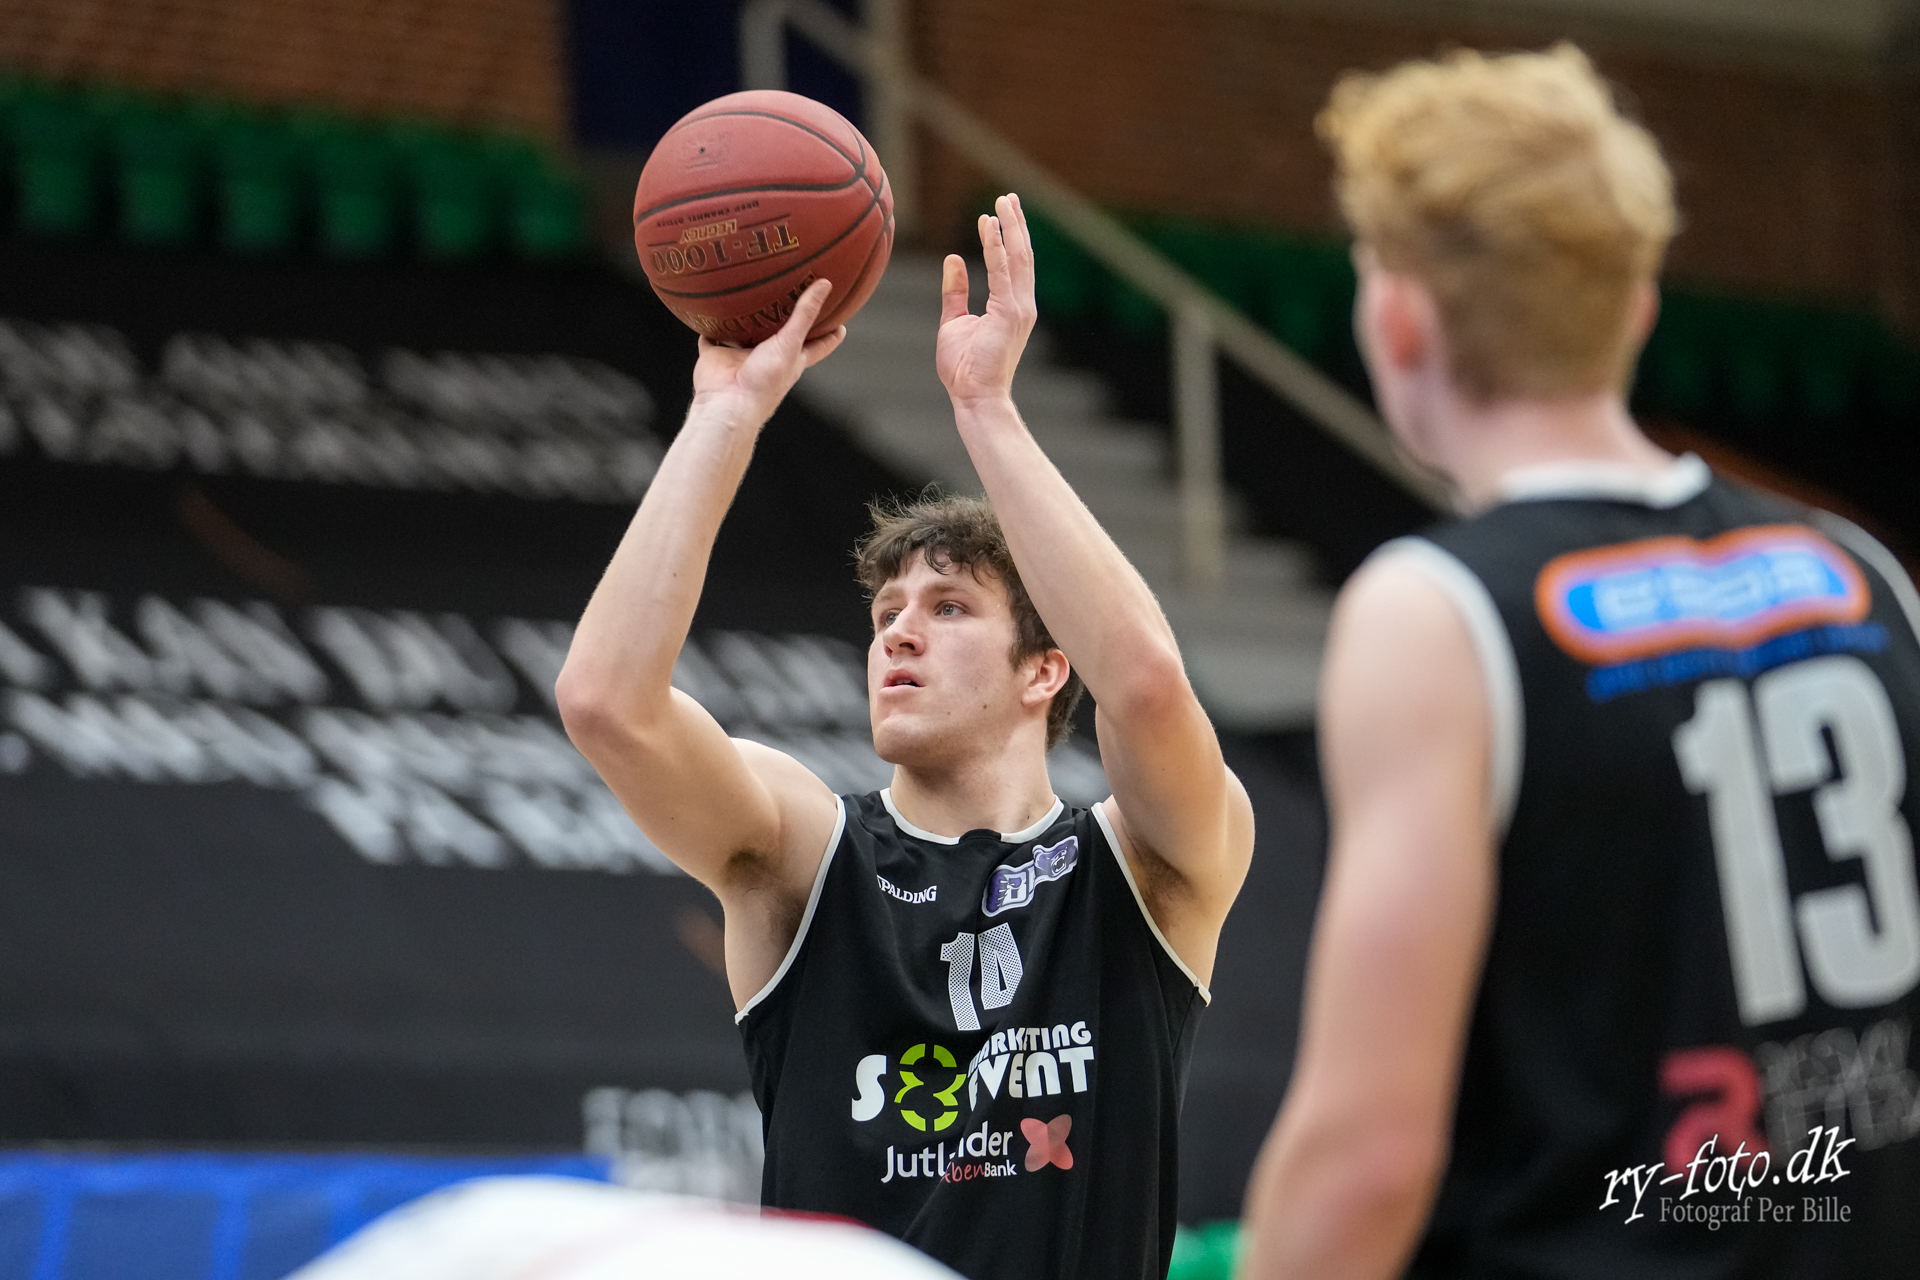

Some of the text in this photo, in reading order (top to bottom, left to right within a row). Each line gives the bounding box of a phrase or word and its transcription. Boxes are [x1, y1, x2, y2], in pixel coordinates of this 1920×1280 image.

[651, 220, 800, 277] TF-1000
[679, 219, 737, 244] LEGACY
[1670, 653, 1920, 1026] 13
[880, 1120, 1014, 1184] Jutlder
